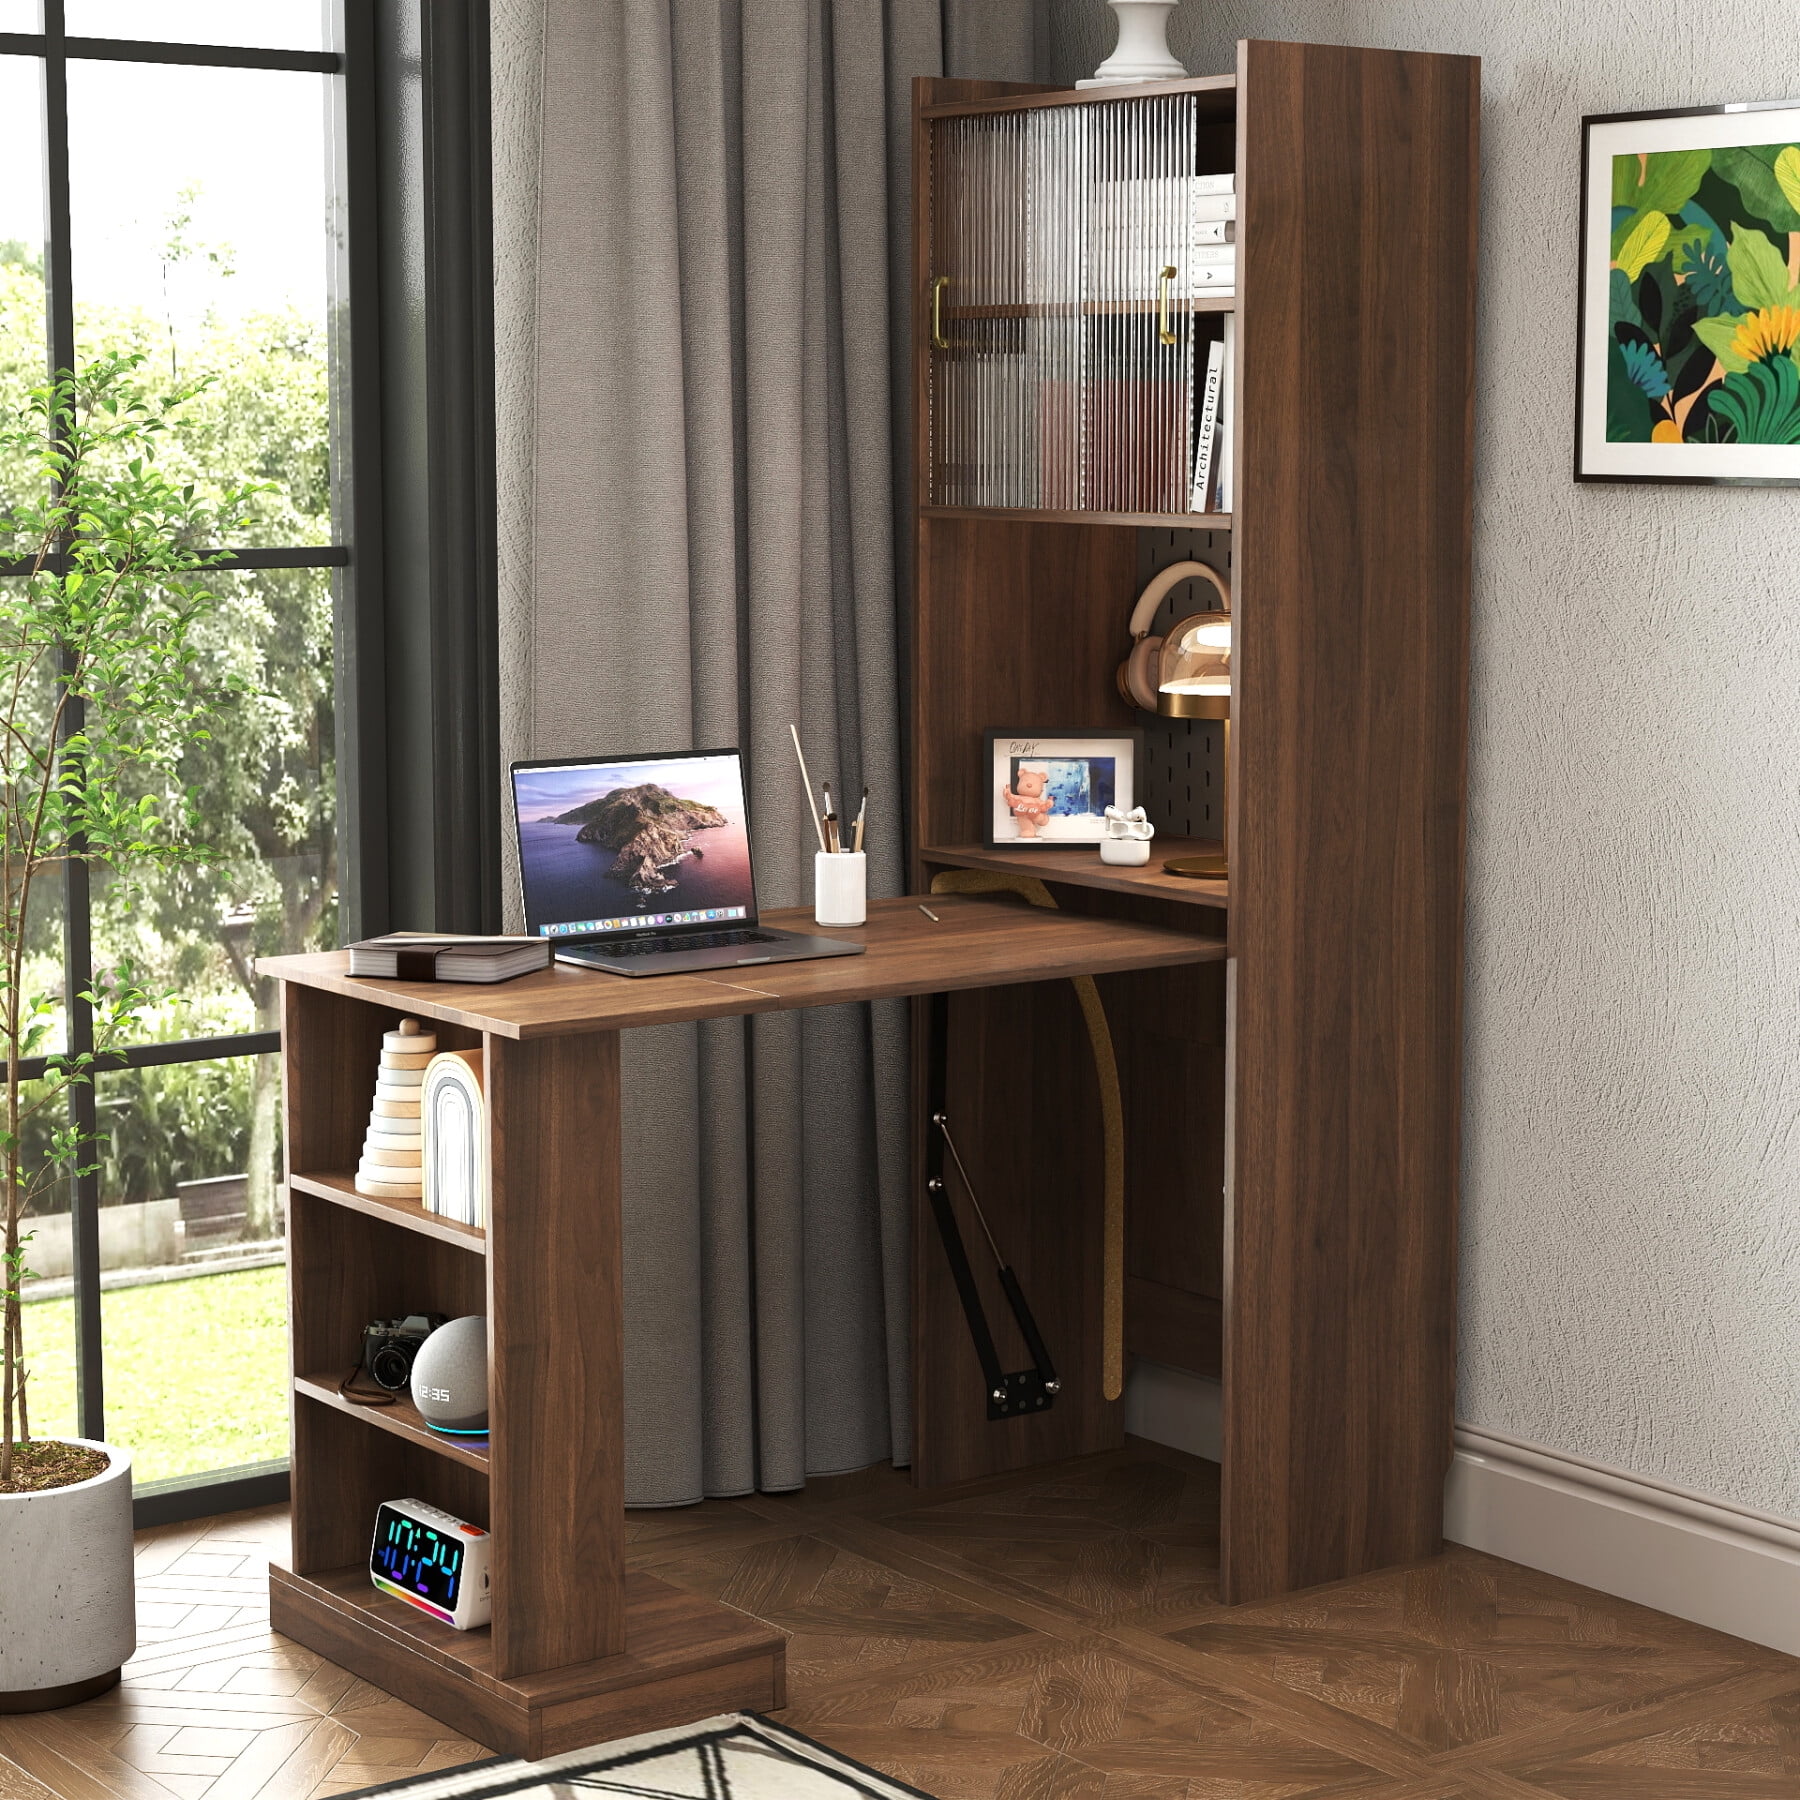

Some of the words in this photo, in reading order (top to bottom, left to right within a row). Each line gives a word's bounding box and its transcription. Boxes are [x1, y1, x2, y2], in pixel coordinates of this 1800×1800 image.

[1196, 367, 1219, 490] Architectural
[419, 1384, 450, 1402] 12:35
[378, 1519, 459, 1599] 10:24
